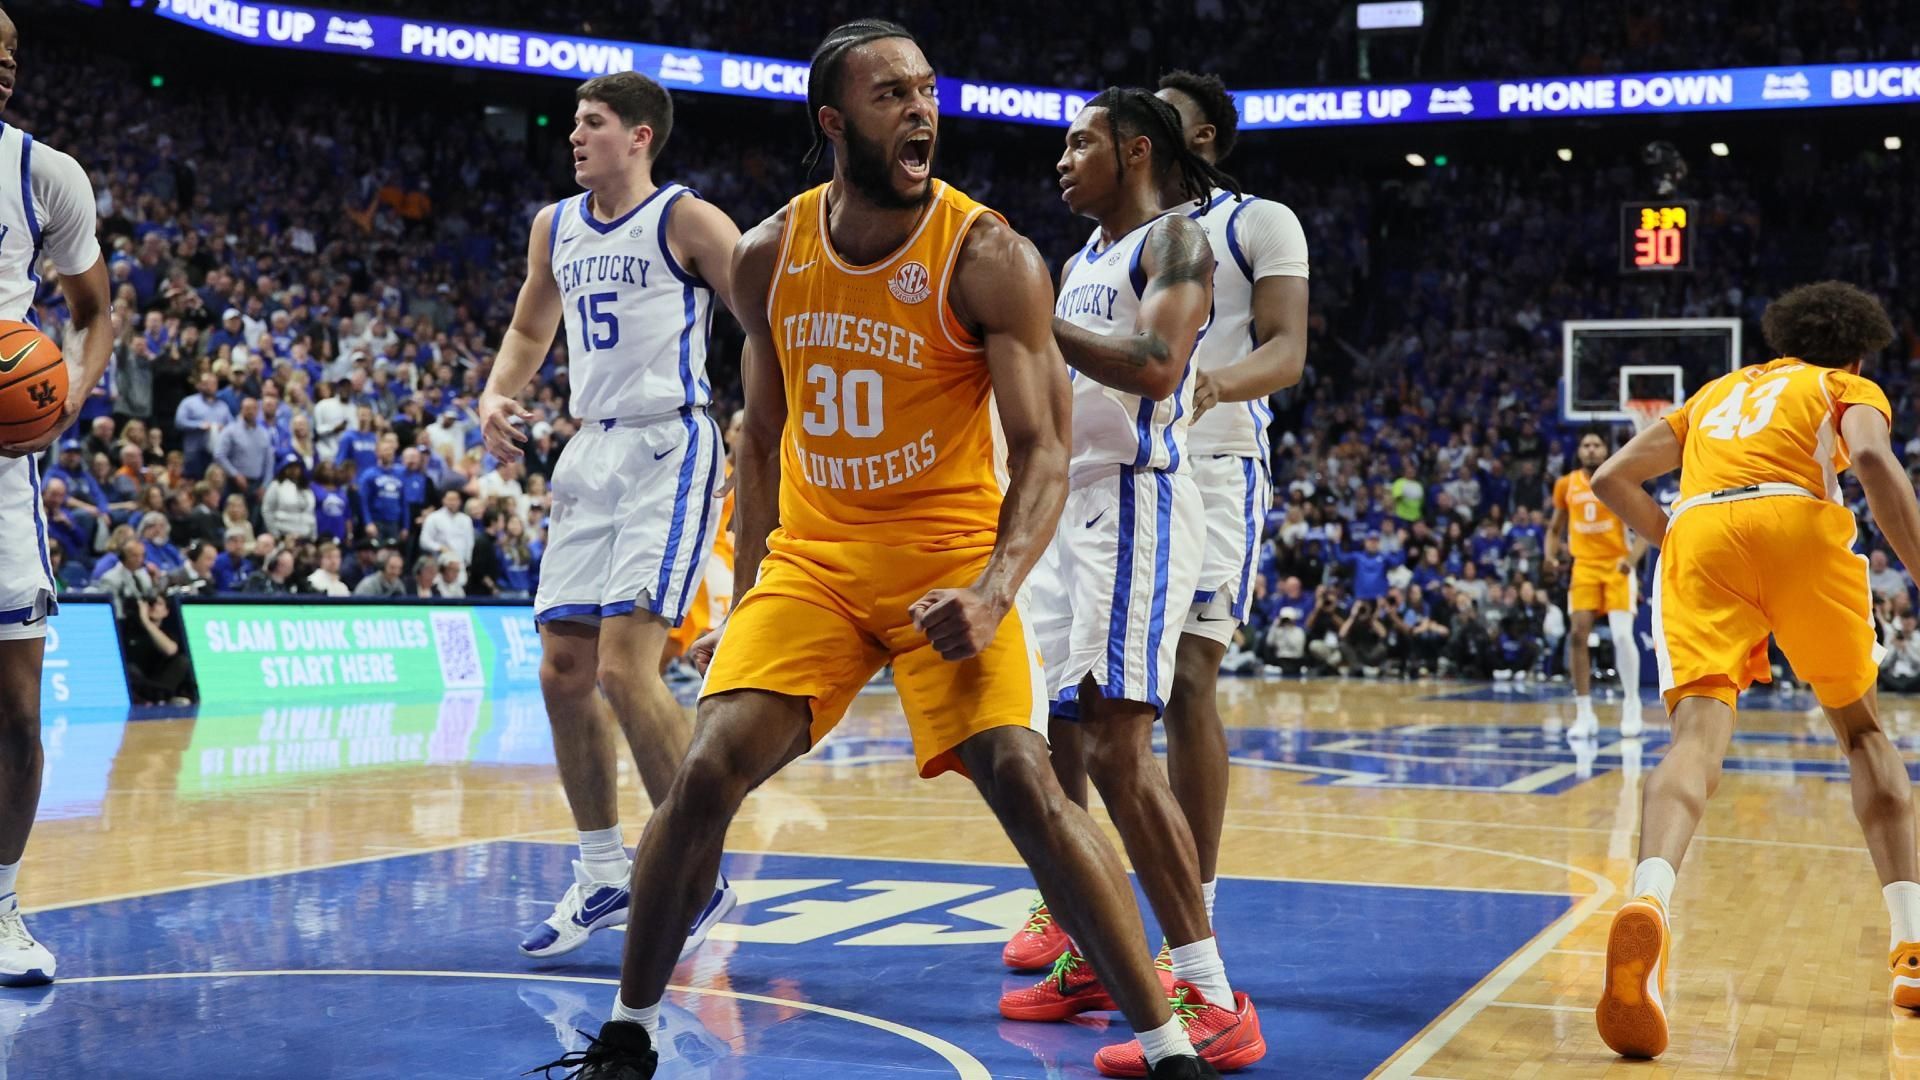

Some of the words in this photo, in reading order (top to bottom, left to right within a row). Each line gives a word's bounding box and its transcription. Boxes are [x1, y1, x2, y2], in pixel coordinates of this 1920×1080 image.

[266, 9, 316, 42] UP
[401, 23, 521, 65] PHONE
[525, 37, 634, 75] DOWN
[720, 58, 811, 96] BUCK
[1499, 80, 1615, 113] PHONE
[1620, 74, 1733, 108] DOWN
[1830, 67, 1920, 99] BUCK
[960, 83, 1062, 121] PHONE
[1243, 91, 1363, 124] BUCKLE
[1367, 89, 1412, 119] UP
[1635, 229, 1680, 266] 30
[898, 263, 927, 293] SEC
[1058, 283, 1118, 321] NTUCKY
[577, 291, 619, 352] 15
[784, 311, 925, 370] TENNESSEE
[27, 379, 57, 410] UK
[802, 363, 884, 438] 30
[1698, 377, 1789, 440] 43
[799, 429, 937, 491] LUNTEERS
[1584, 502, 1597, 522] 0
[205, 619, 277, 652] SLAM
[280, 619, 350, 651] DUNK
[352, 618, 428, 649] SMILES
[260, 654, 336, 688] START
[339, 653, 398, 684] HERE
